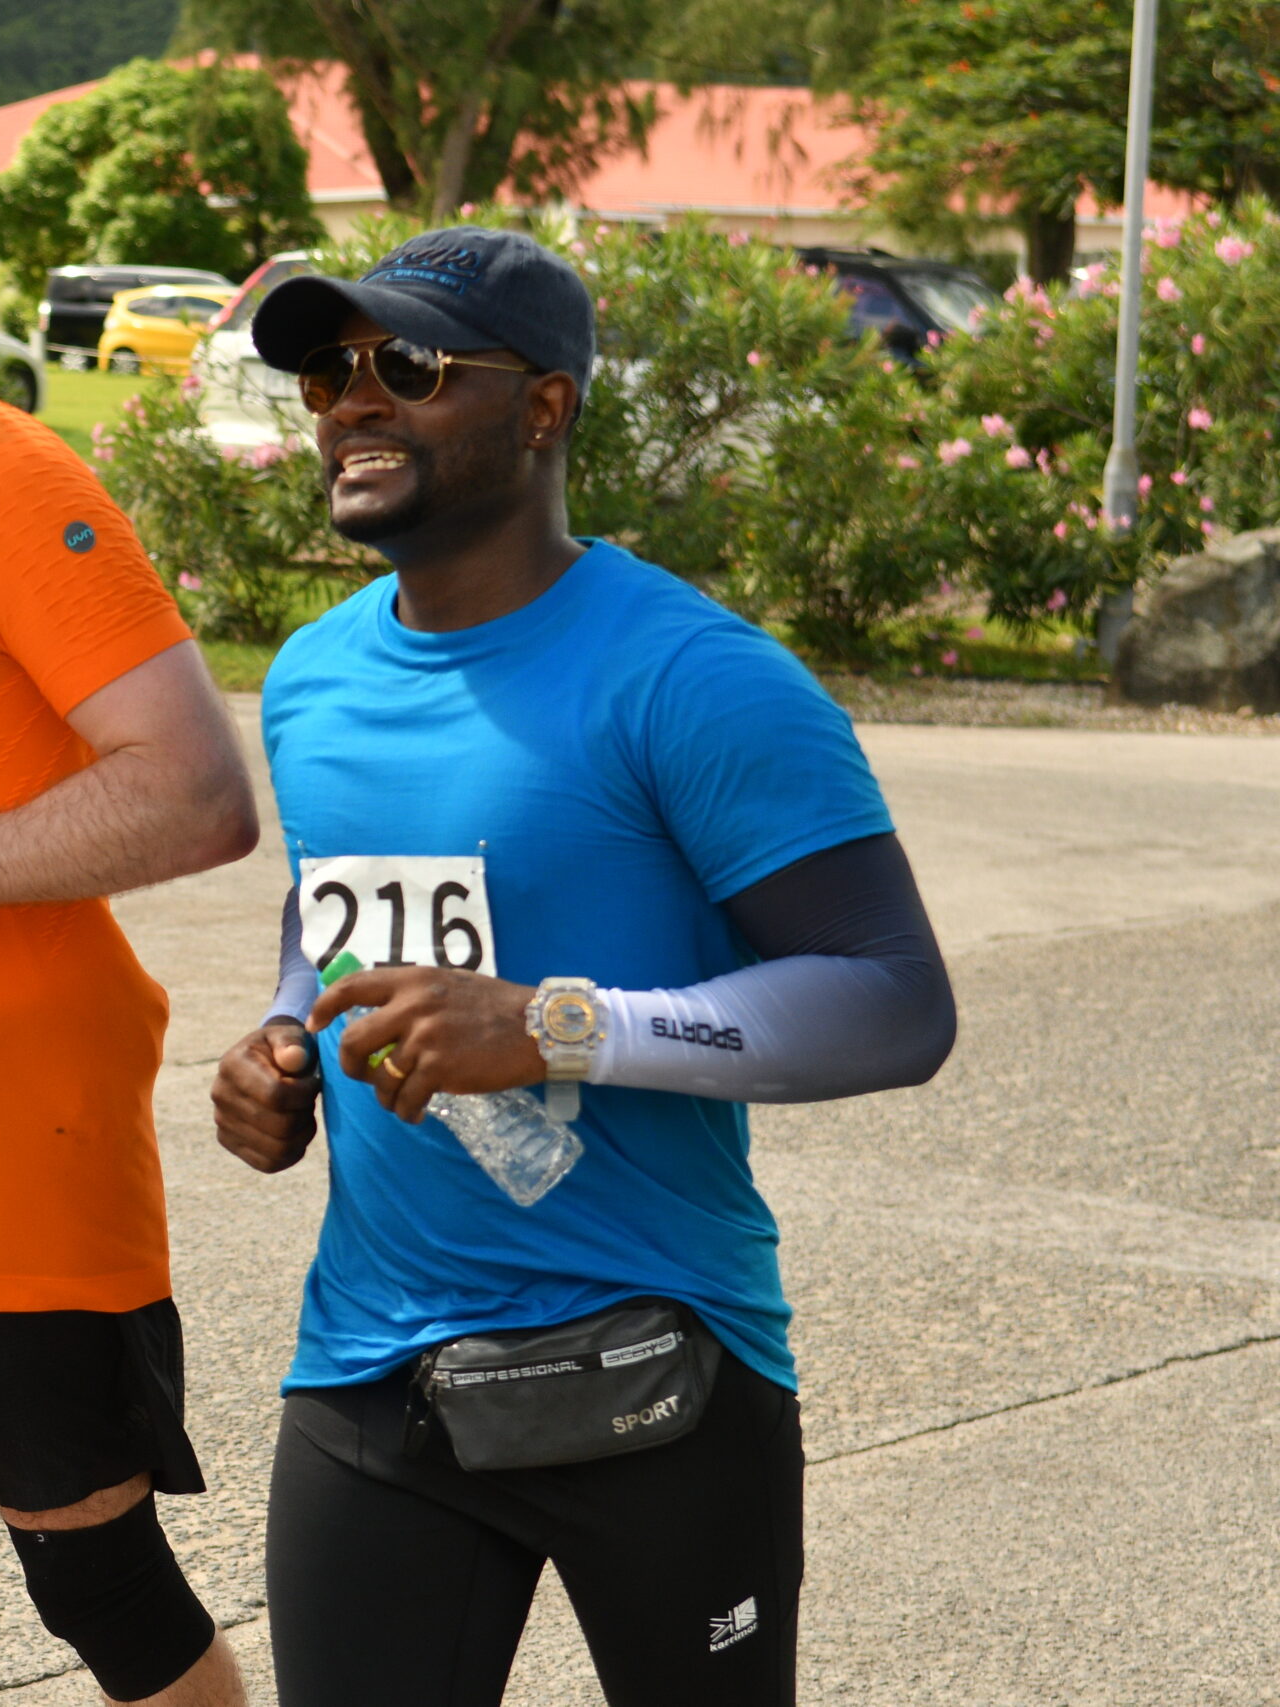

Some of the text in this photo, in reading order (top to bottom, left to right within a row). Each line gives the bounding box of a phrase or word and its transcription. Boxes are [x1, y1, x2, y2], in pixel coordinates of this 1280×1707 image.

[312, 881, 483, 973] 216
[651, 1017, 743, 1051] SPORTS
[453, 1361, 583, 1385] PROFESSIONAL
[612, 1395, 678, 1434] SPORT
